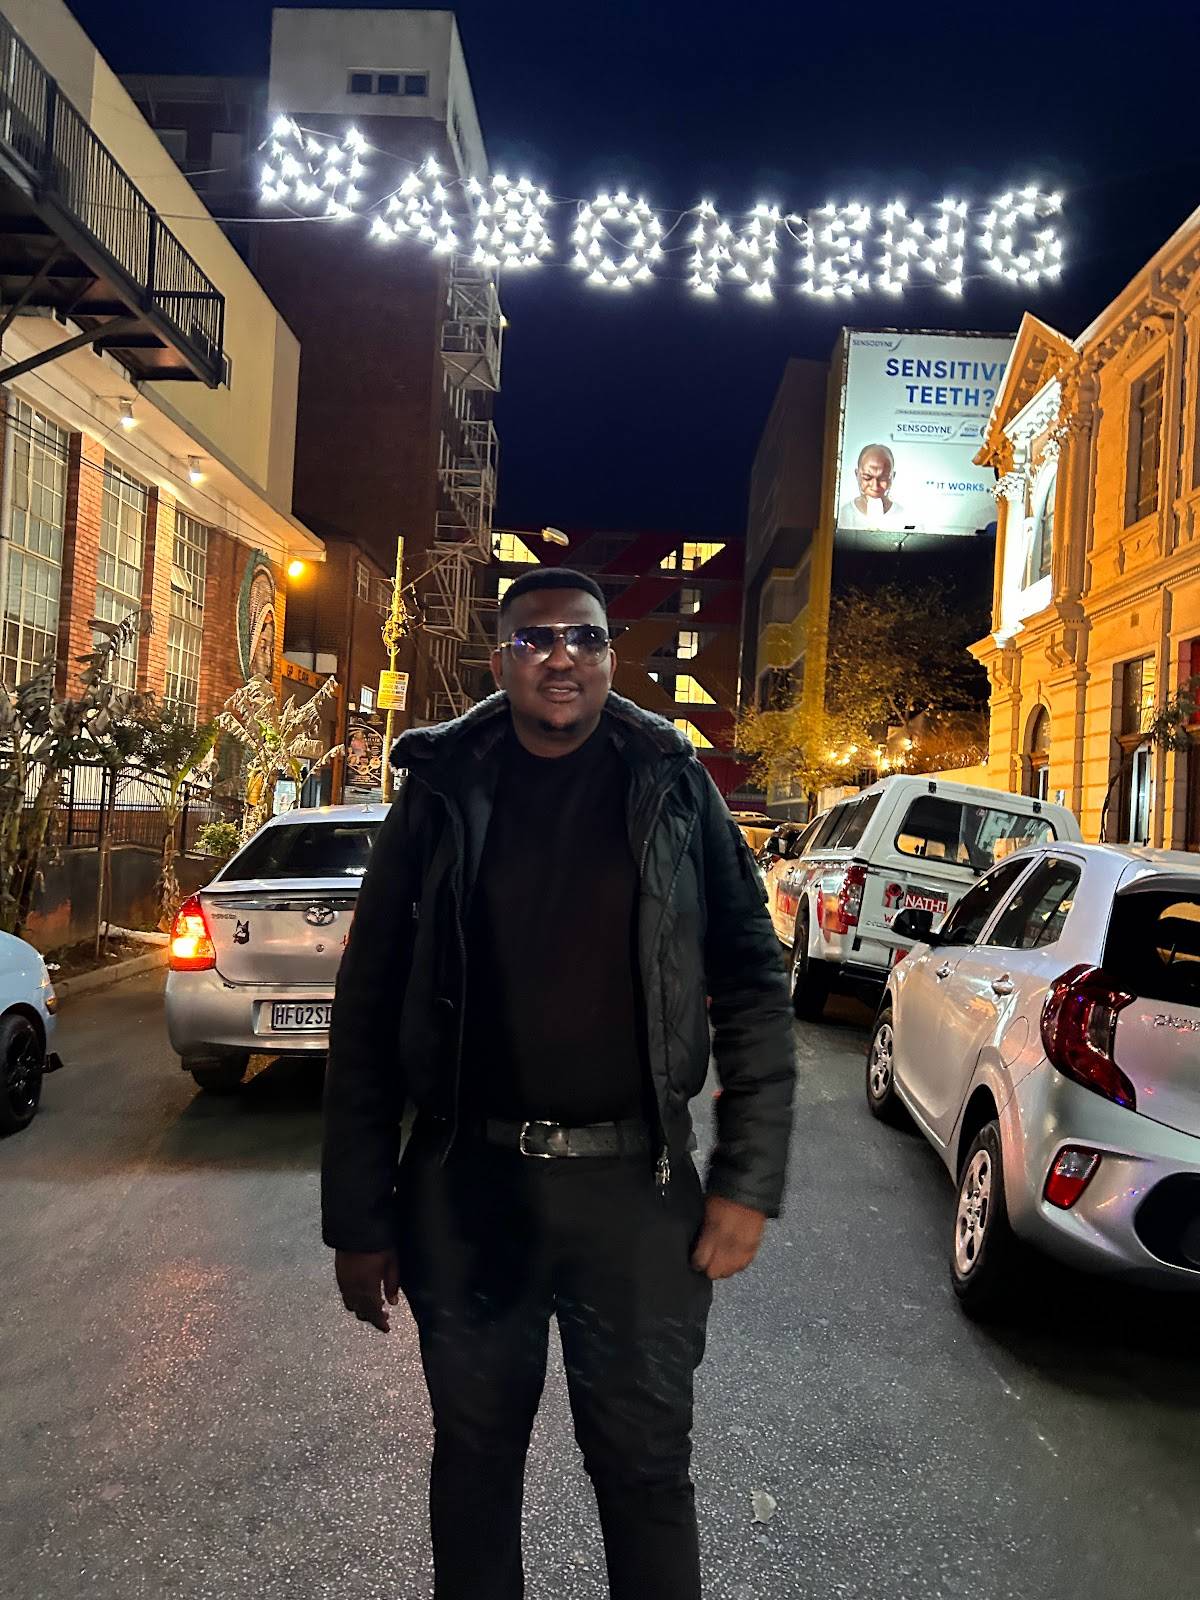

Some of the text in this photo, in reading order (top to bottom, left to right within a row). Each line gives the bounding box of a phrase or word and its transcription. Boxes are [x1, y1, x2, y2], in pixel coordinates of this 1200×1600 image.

[852, 338, 894, 349] SENSODYNE
[905, 384, 995, 408] TEETH?
[896, 423, 953, 435] SENSODYNE
[904, 894, 947, 914] NATHI
